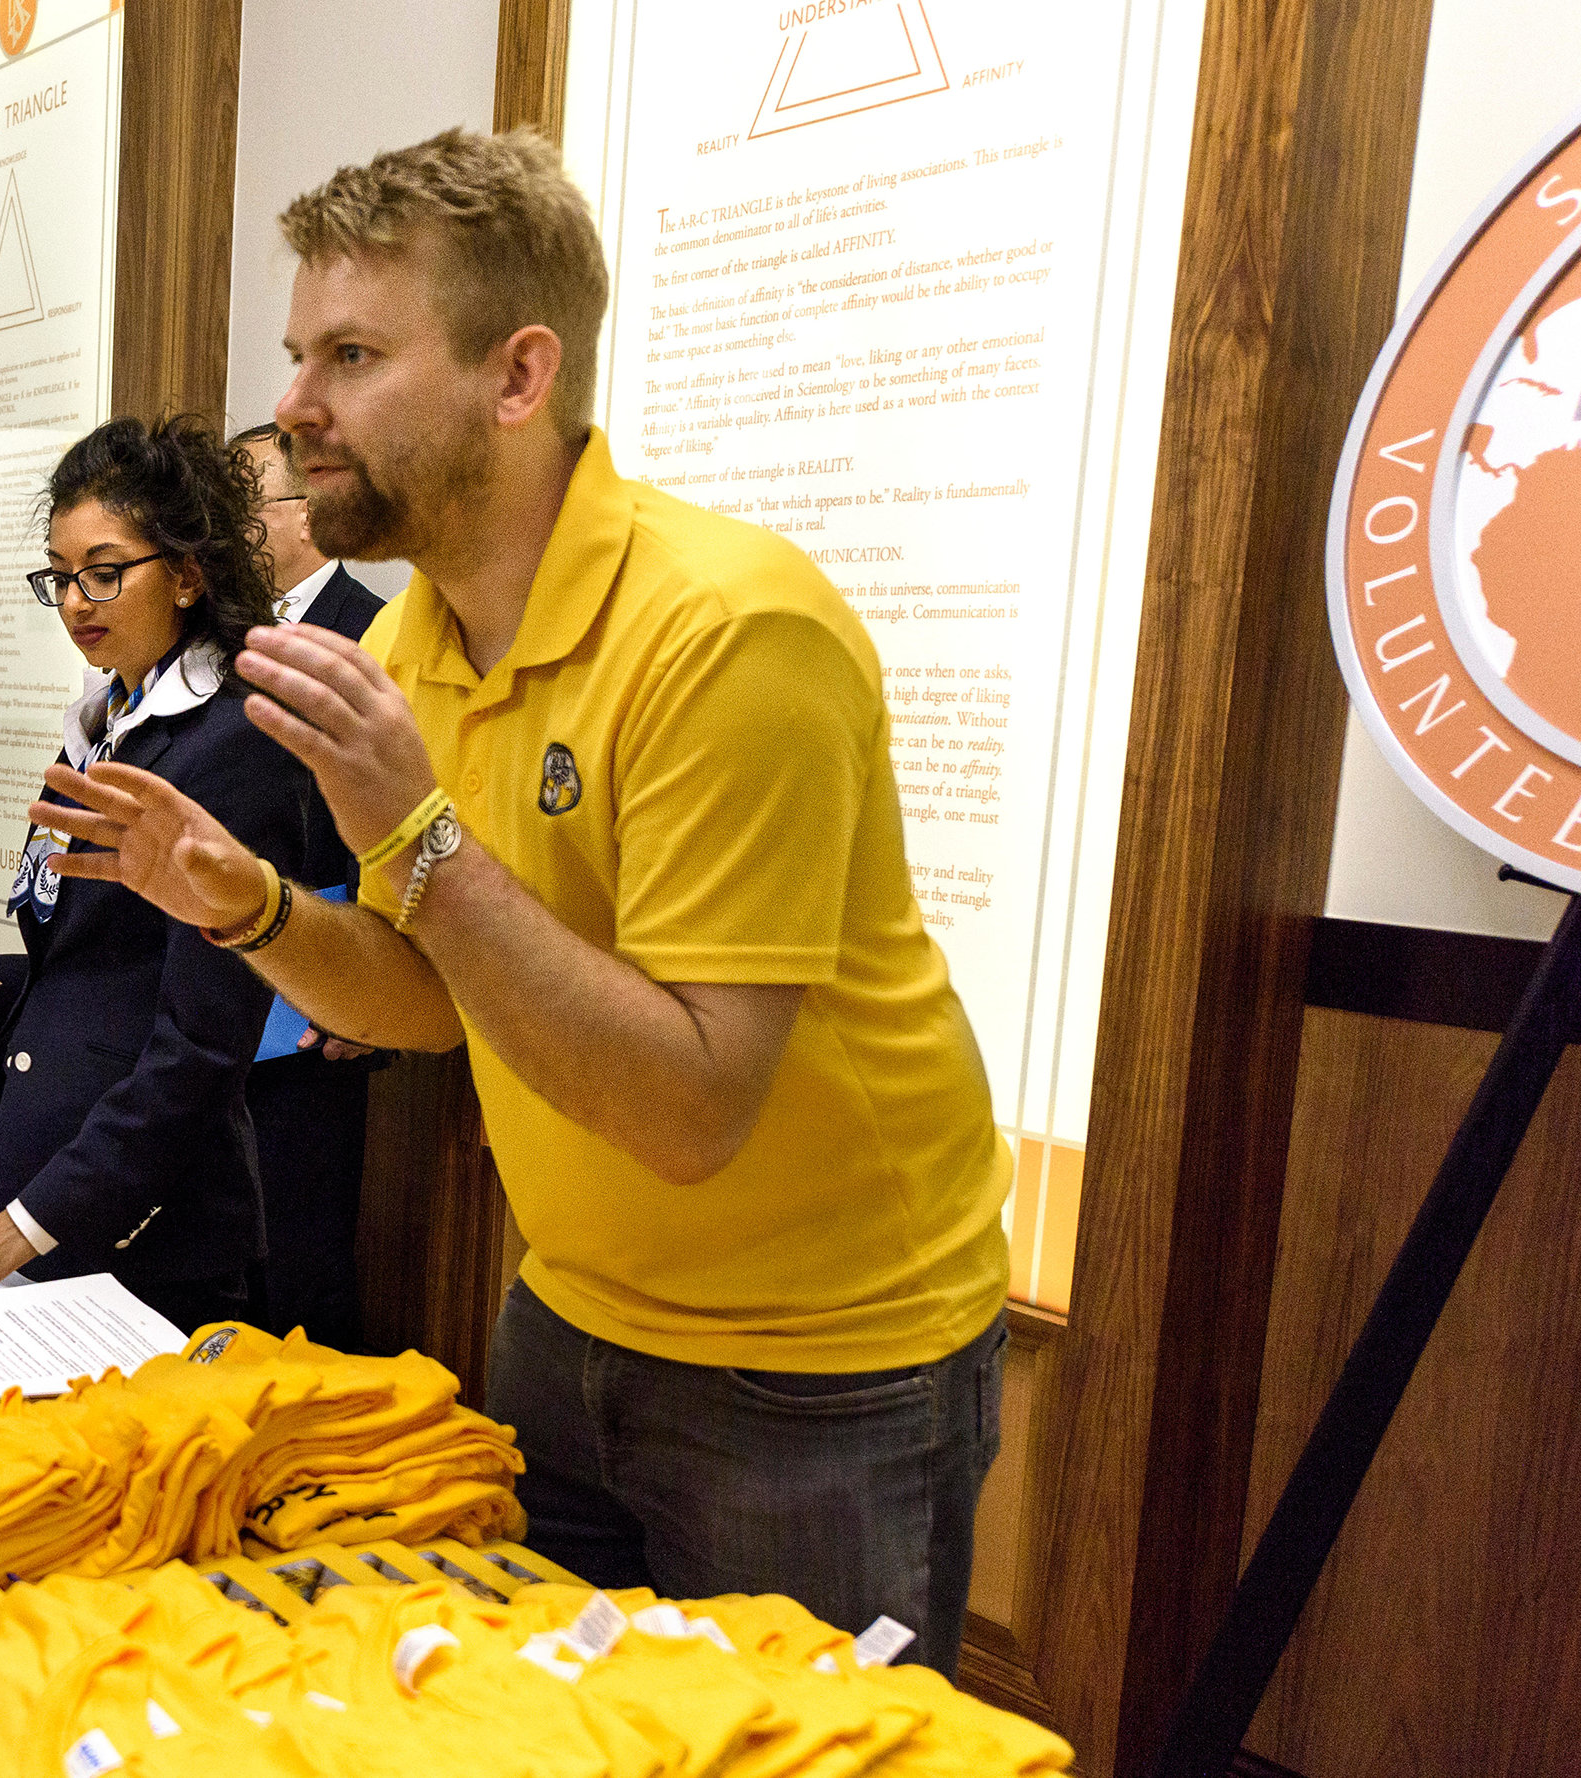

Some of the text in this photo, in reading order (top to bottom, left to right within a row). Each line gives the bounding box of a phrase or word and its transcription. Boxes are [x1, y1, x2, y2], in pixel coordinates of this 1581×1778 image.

[961, 60, 1025, 89] AFFINITY
[4, 80, 68, 128] TRIANGLE
[696, 133, 740, 157] REALITY
[655, 134, 1063, 236] The A-R-C TRIANGLE is the keystone of living associations. This triangle is
[653, 197, 888, 257] the common denominator to all of life's activities.
[651, 227, 896, 288] The first corner of the triangle is called AFFINITY.
[649, 305, 667, 320] The
[737, 288, 749, 306] of
[748, 285, 785, 304] affinity
[786, 283, 795, 297] is
[819, 268, 888, 292] consideration
[890, 260, 904, 280] of
[904, 259, 953, 277] distance,
[956, 247, 1004, 267] whether
[1005, 238, 1037, 264] good
[1039, 241, 1054, 254] or
[644, 379, 662, 395] The
[664, 375, 688, 392] word
[689, 371, 725, 390] affinity
[727, 370, 735, 384] is
[788, 364, 800, 376] to
[801, 360, 831, 374] mean
[866, 347, 903, 366] liking
[904, 348, 919, 360] or
[920, 345, 944, 361] any
[946, 337, 979, 355] other
[981, 325, 1045, 350] emotional
[673, 437, 685, 454] of
[655, 470, 686, 489] second
[687, 472, 717, 485] corner
[718, 466, 731, 482] of
[730, 465, 747, 481] the
[747, 462, 785, 483] triangle
[787, 463, 795, 477] is
[797, 455, 854, 476] REALITY.
[707, 499, 742, 515] defined
[743, 501, 754, 513] as
[780, 493, 813, 511] which
[813, 495, 853, 513] appears
[855, 493, 867, 506] to
[891, 485, 932, 505] Reality
[933, 485, 943, 500] is
[945, 478, 1031, 499] fundamentally
[774, 517, 794, 533] real
[794, 517, 804, 532] is
[805, 514, 827, 532] real.
[807, 543, 906, 566] MUNICATION.
[855, 582, 867, 598] in
[868, 580, 888, 598] this
[889, 581, 934, 597] universe,
[935, 579, 1020, 595] communication
[866, 602, 909, 624] triangle.
[912, 603, 1006, 620] Communication
[1008, 603, 1019, 619] is
[882, 662, 1012, 681] at once when one asks,
[884, 684, 1011, 709] a high degree of liking
[888, 711, 1010, 728] unication. Without
[887, 732, 1006, 757] ere can be no reality.
[902, 760, 923, 772] can
[924, 756, 940, 773] be
[941, 759, 958, 774] no
[958, 758, 1004, 781] affinity.
[896, 780, 1003, 805] orners of a triangle,
[899, 802, 1000, 825] iangle, one must
[908, 862, 995, 887] nity and reality
[910, 883, 993, 912] hat the triangle
